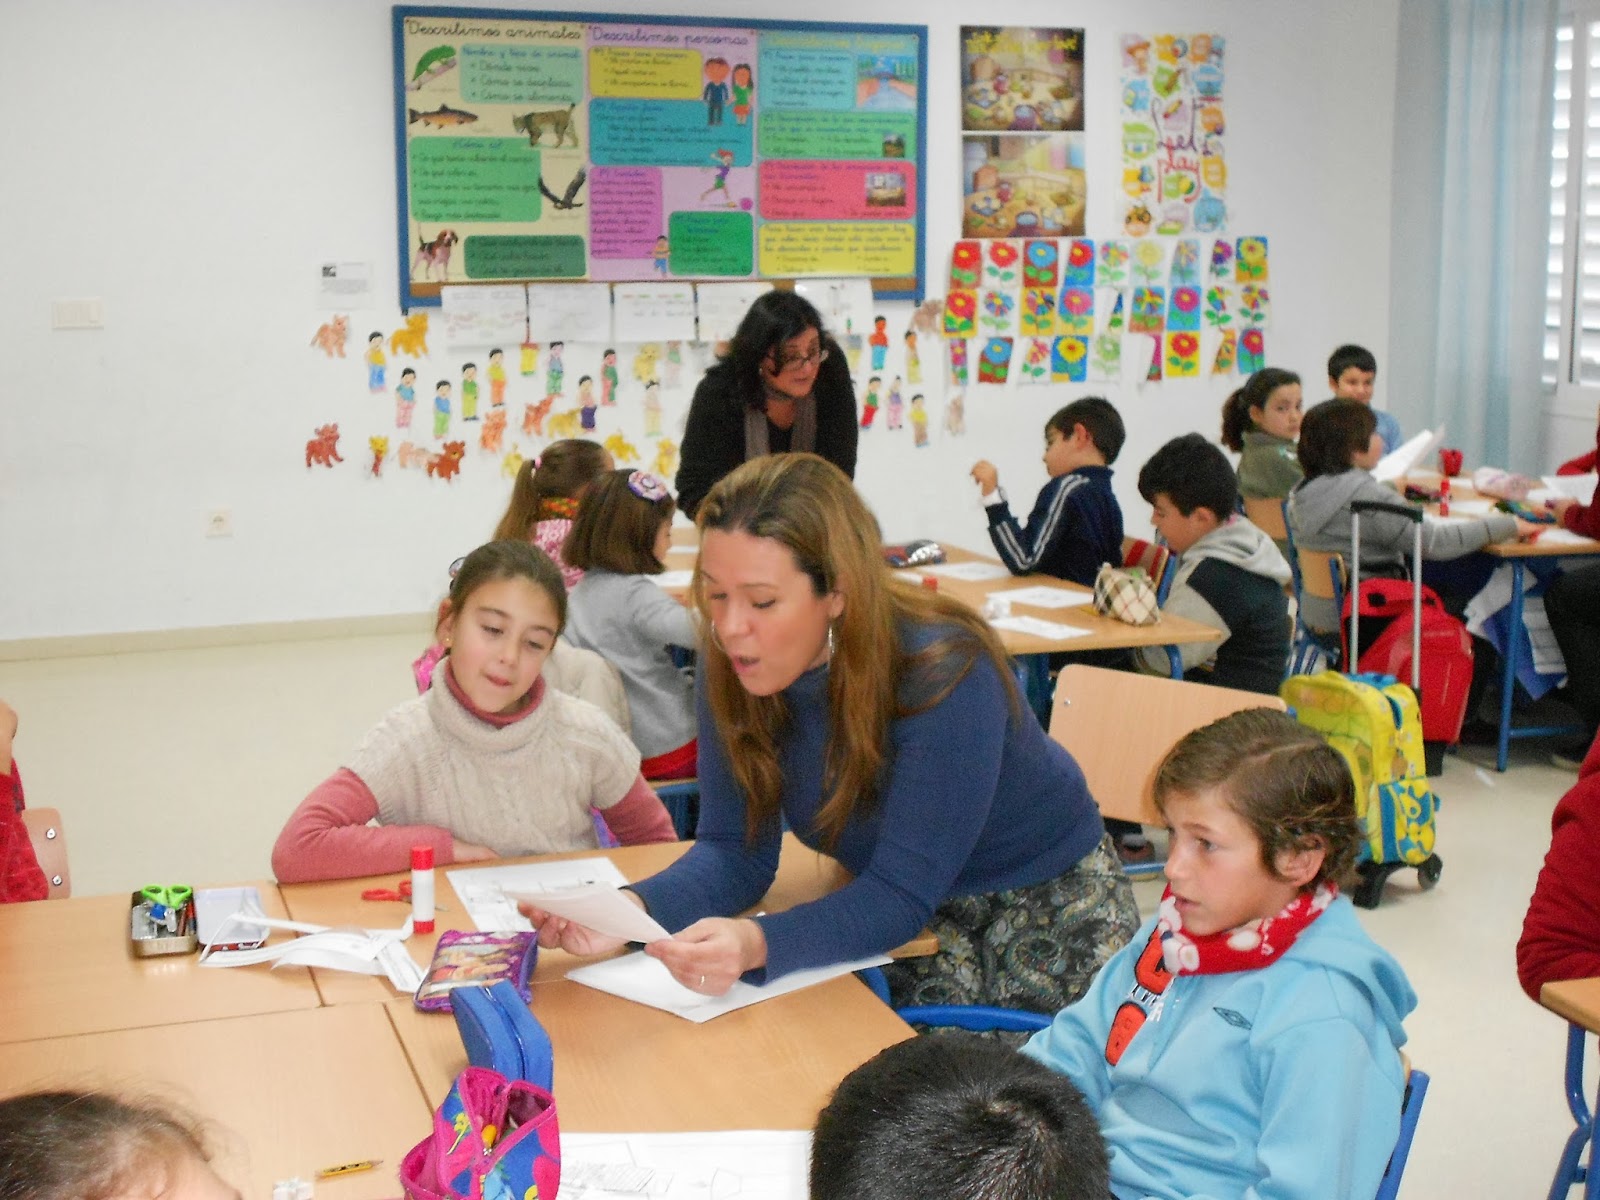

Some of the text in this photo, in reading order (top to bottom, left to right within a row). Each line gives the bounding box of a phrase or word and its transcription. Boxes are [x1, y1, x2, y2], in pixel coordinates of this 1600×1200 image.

[408, 19, 582, 40] Describimos animales
[592, 26, 749, 50] Describimos personas
